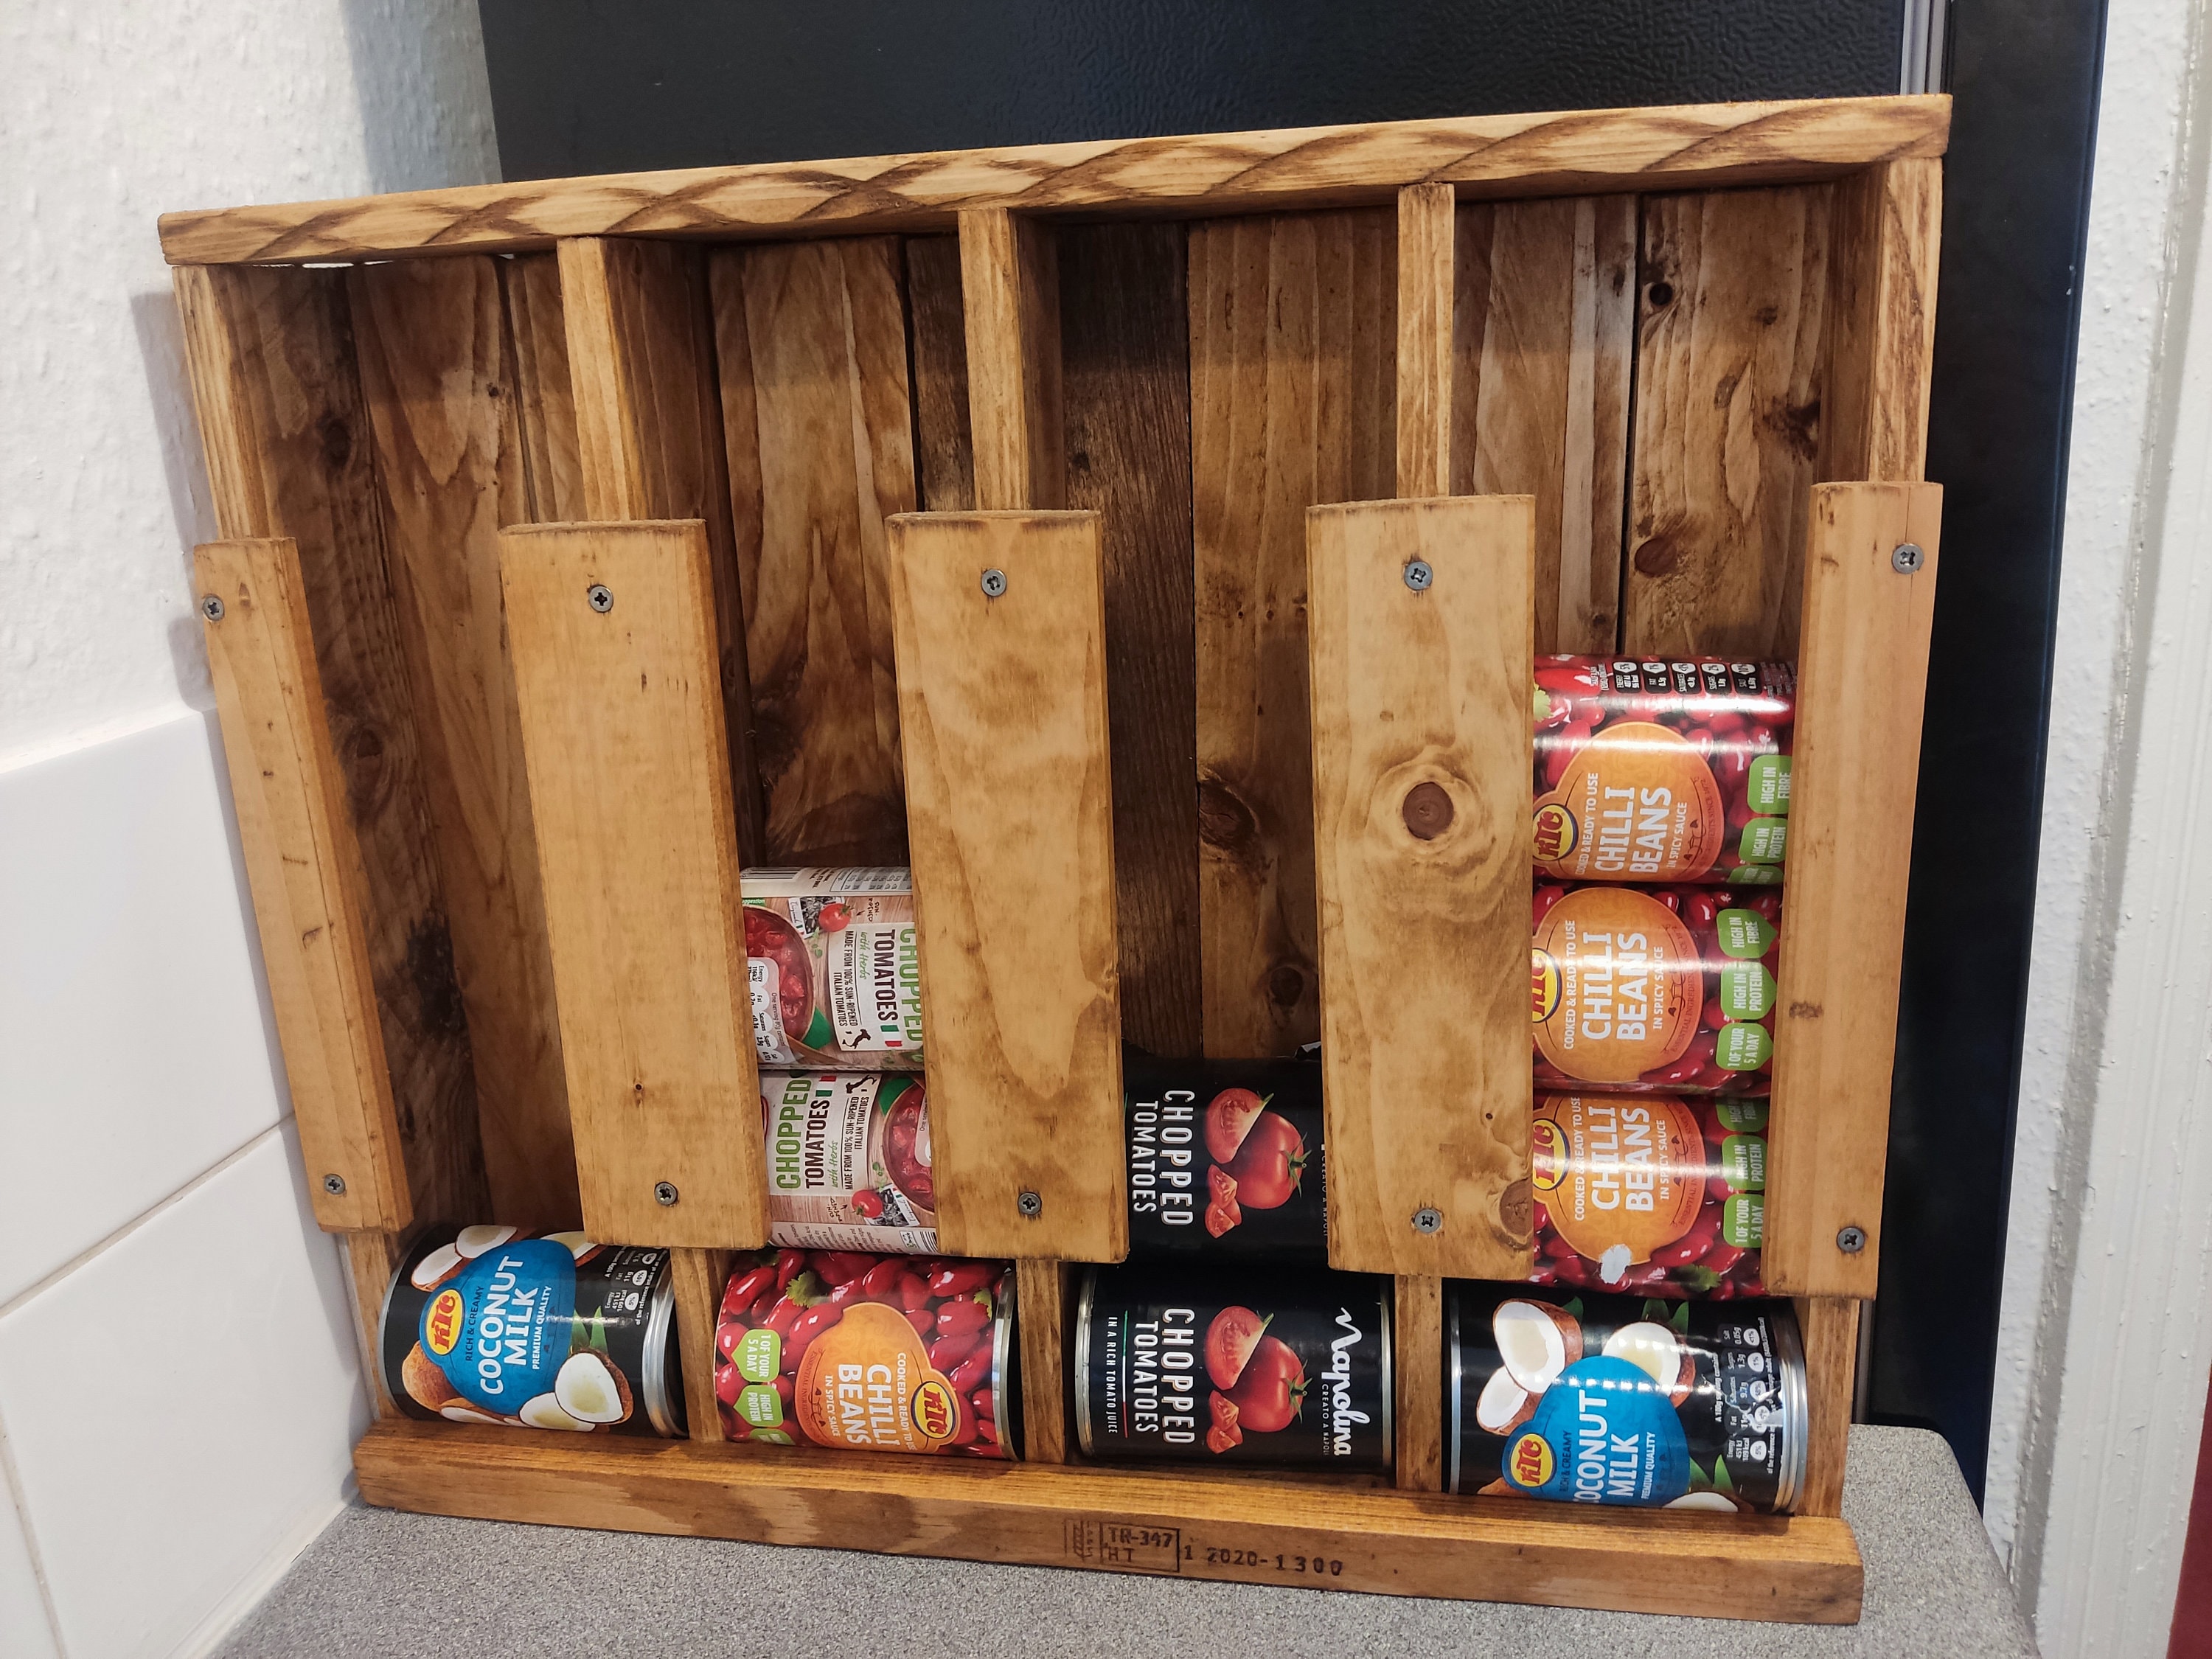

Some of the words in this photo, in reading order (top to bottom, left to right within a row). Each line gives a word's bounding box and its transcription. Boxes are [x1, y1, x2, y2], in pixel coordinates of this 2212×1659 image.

[1587, 772, 1599, 796] USE
[1762, 767, 1777, 777] IN
[1760, 779, 1775, 804] HIGH
[1778, 772, 1792, 799] FIBRE
[1586, 797, 1596, 813] TO
[1594, 786, 1635, 872] CHILLI
[1629, 787, 1672, 873] BEANS
[1674, 801, 1688, 835] SAUCE
[1582, 815, 1595, 846] READY
[1756, 827, 1770, 837] IN
[1767, 827, 1787, 858] PROTEIN
[1669, 836, 1683, 860] SPICY
[1751, 838, 1768, 857] HIGH
[1666, 860, 1676, 868] IN
[1565, 920, 1576, 939] USE
[1729, 917, 1742, 925] IN
[1745, 920, 1760, 944] FIBRE
[844, 931, 854, 948] MADE
[860, 931, 870, 950] with
[1731, 927, 1745, 947] HIGH
[844, 949, 853, 967] FROM
[1566, 942, 1576, 957] TO
[859, 953, 871, 980] Herbs
[874, 928, 899, 1021] TOMATOES
[1653, 946, 1663, 981] SAUCE
[833, 972, 844, 996] ITALIAN
[844, 969, 853, 985] 100%
[899, 928, 922, 1042] CHOPPED
[1566, 959, 1576, 995] READY
[1582, 931, 1613, 1040] CHILLI
[1616, 932, 1647, 1040] BEANS
[1733, 973, 1747, 983] IN
[1566, 998, 1576, 1006] &
[1654, 984, 1664, 1015] SPICY
[1733, 985, 1747, 1009] HIGH
[1749, 970, 1762, 1012] PROTEIN
[835, 997, 848, 1026] TOMATOES
[844, 987, 858, 1026] SUN-RIPENED
[1564, 1009, 1576, 1049] COOKED
[1653, 1018, 1663, 1029] IN
[1730, 1028, 1745, 1050] YOUR
[1746, 1033, 1760, 1050] DAY
[1728, 1051, 1741, 1062] OF
[1745, 1050, 1758, 1058] A
[846, 1096, 859, 1135] SUN-RIPENED
[856, 1096, 869, 1126] TOMATOES
[1571, 1096, 1582, 1113] USE
[1573, 1114, 1582, 1127] TO
[776, 1079, 812, 1189] CHOPPED
[804, 1099, 830, 1189] TOMATOES
[844, 1136, 853, 1153] 100%
[854, 1126, 863, 1150] ITALIAN
[1656, 1119, 1667, 1151] SAUCE
[828, 1141, 838, 1166] Herbs
[1132, 1100, 1158, 1213] TOMATOES
[1160, 1090, 1195, 1226] CHOPPED
[1573, 1130, 1584, 1165] READY
[1588, 1106, 1620, 1210] CHILLI
[1621, 1107, 1654, 1211] BEANS
[1734, 1145, 1747, 1154] IN
[844, 1154, 852, 1172] FROM
[1575, 1166, 1584, 1175] &
[1658, 1155, 1669, 1184] SPICY
[1735, 1158, 1748, 1179] HIGH
[1749, 1144, 1764, 1182] PROTEIN
[827, 1167, 838, 1188] with
[844, 1173, 854, 1190] MADE
[1575, 1175, 1585, 1221] COOKED
[1660, 1188, 1669, 1200] IN
[1736, 1199, 1749, 1222] YOUR
[1751, 1206, 1764, 1222] DAY
[1736, 1223, 1748, 1237] OF
[1751, 1224, 1763, 1232] A
[624, 1271, 634, 1282] 11g
[469, 1286, 484, 1324] CREAMY
[537, 1285, 552, 1324] QUALITY
[605, 1291, 615, 1309] Energy
[629, 1296, 636, 1306] 5%
[639, 1286, 649, 1309] reference
[434, 1293, 456, 1350] KTC
[467, 1326, 476, 1337] &
[478, 1255, 523, 1395] COCONUT
[504, 1287, 538, 1366] MILK
[1107, 1316, 1118, 1327] IN
[1107, 1329, 1117, 1338] A
[760, 1341, 771, 1352] OF
[1733, 1326, 1742, 1345] 0.05g
[465, 1337, 474, 1362] RICH
[532, 1326, 543, 1370] PREMIUM
[1107, 1341, 1117, 1366] RICH
[747, 1354, 757, 1372] DAY
[759, 1353, 771, 1377] YOUR
[1728, 1352, 1736, 1370] Sugars
[1737, 1354, 1746, 1368] 1.3g
[825, 1374, 833, 1386] IN
[897, 1352, 906, 1395] COOKED
[1133, 1321, 1159, 1433] TOMATOES
[1161, 1307, 1195, 1444] CHOPPED
[1106, 1369, 1116, 1409] TOMATO
[1739, 1382, 1749, 1398] 9.7g
[748, 1392, 762, 1422] PROTEIN
[759, 1394, 773, 1413] HIGH
[825, 1389, 835, 1415] SPICY
[838, 1364, 872, 1444] BEANS
[866, 1364, 900, 1446] CHILLI
[923, 1387, 948, 1434] KTC
[1321, 1383, 1329, 1421] CREATO
[1714, 1401, 1723, 1416] 100g
[762, 1413, 774, 1421] IN
[828, 1416, 841, 1437] SAUCE
[898, 1405, 909, 1431] READY
[1106, 1410, 1118, 1434] JUICE
[904, 1432, 913, 1441] TO
[1322, 1431, 1330, 1456] NAPOLI
[1572, 1389, 1607, 1503] OCONUT
[1727, 1439, 1736, 1458] Energy
[1767, 1433, 1775, 1458] reference
[1562, 1430, 1573, 1469] CREAMY
[1645, 1431, 1656, 1471] QUALITY
[1517, 1439, 1542, 1486] KTC
[1562, 1470, 1570, 1478] &
[1607, 1433, 1639, 1497] MILK
[1559, 1477, 1569, 1492] RICH
[1641, 1471, 1654, 1500] PREMIUM
[1108, 1526, 1173, 1548] TR-347
[1108, 1547, 1135, 1562] HT
[1184, 1545, 1193, 1560] 1
